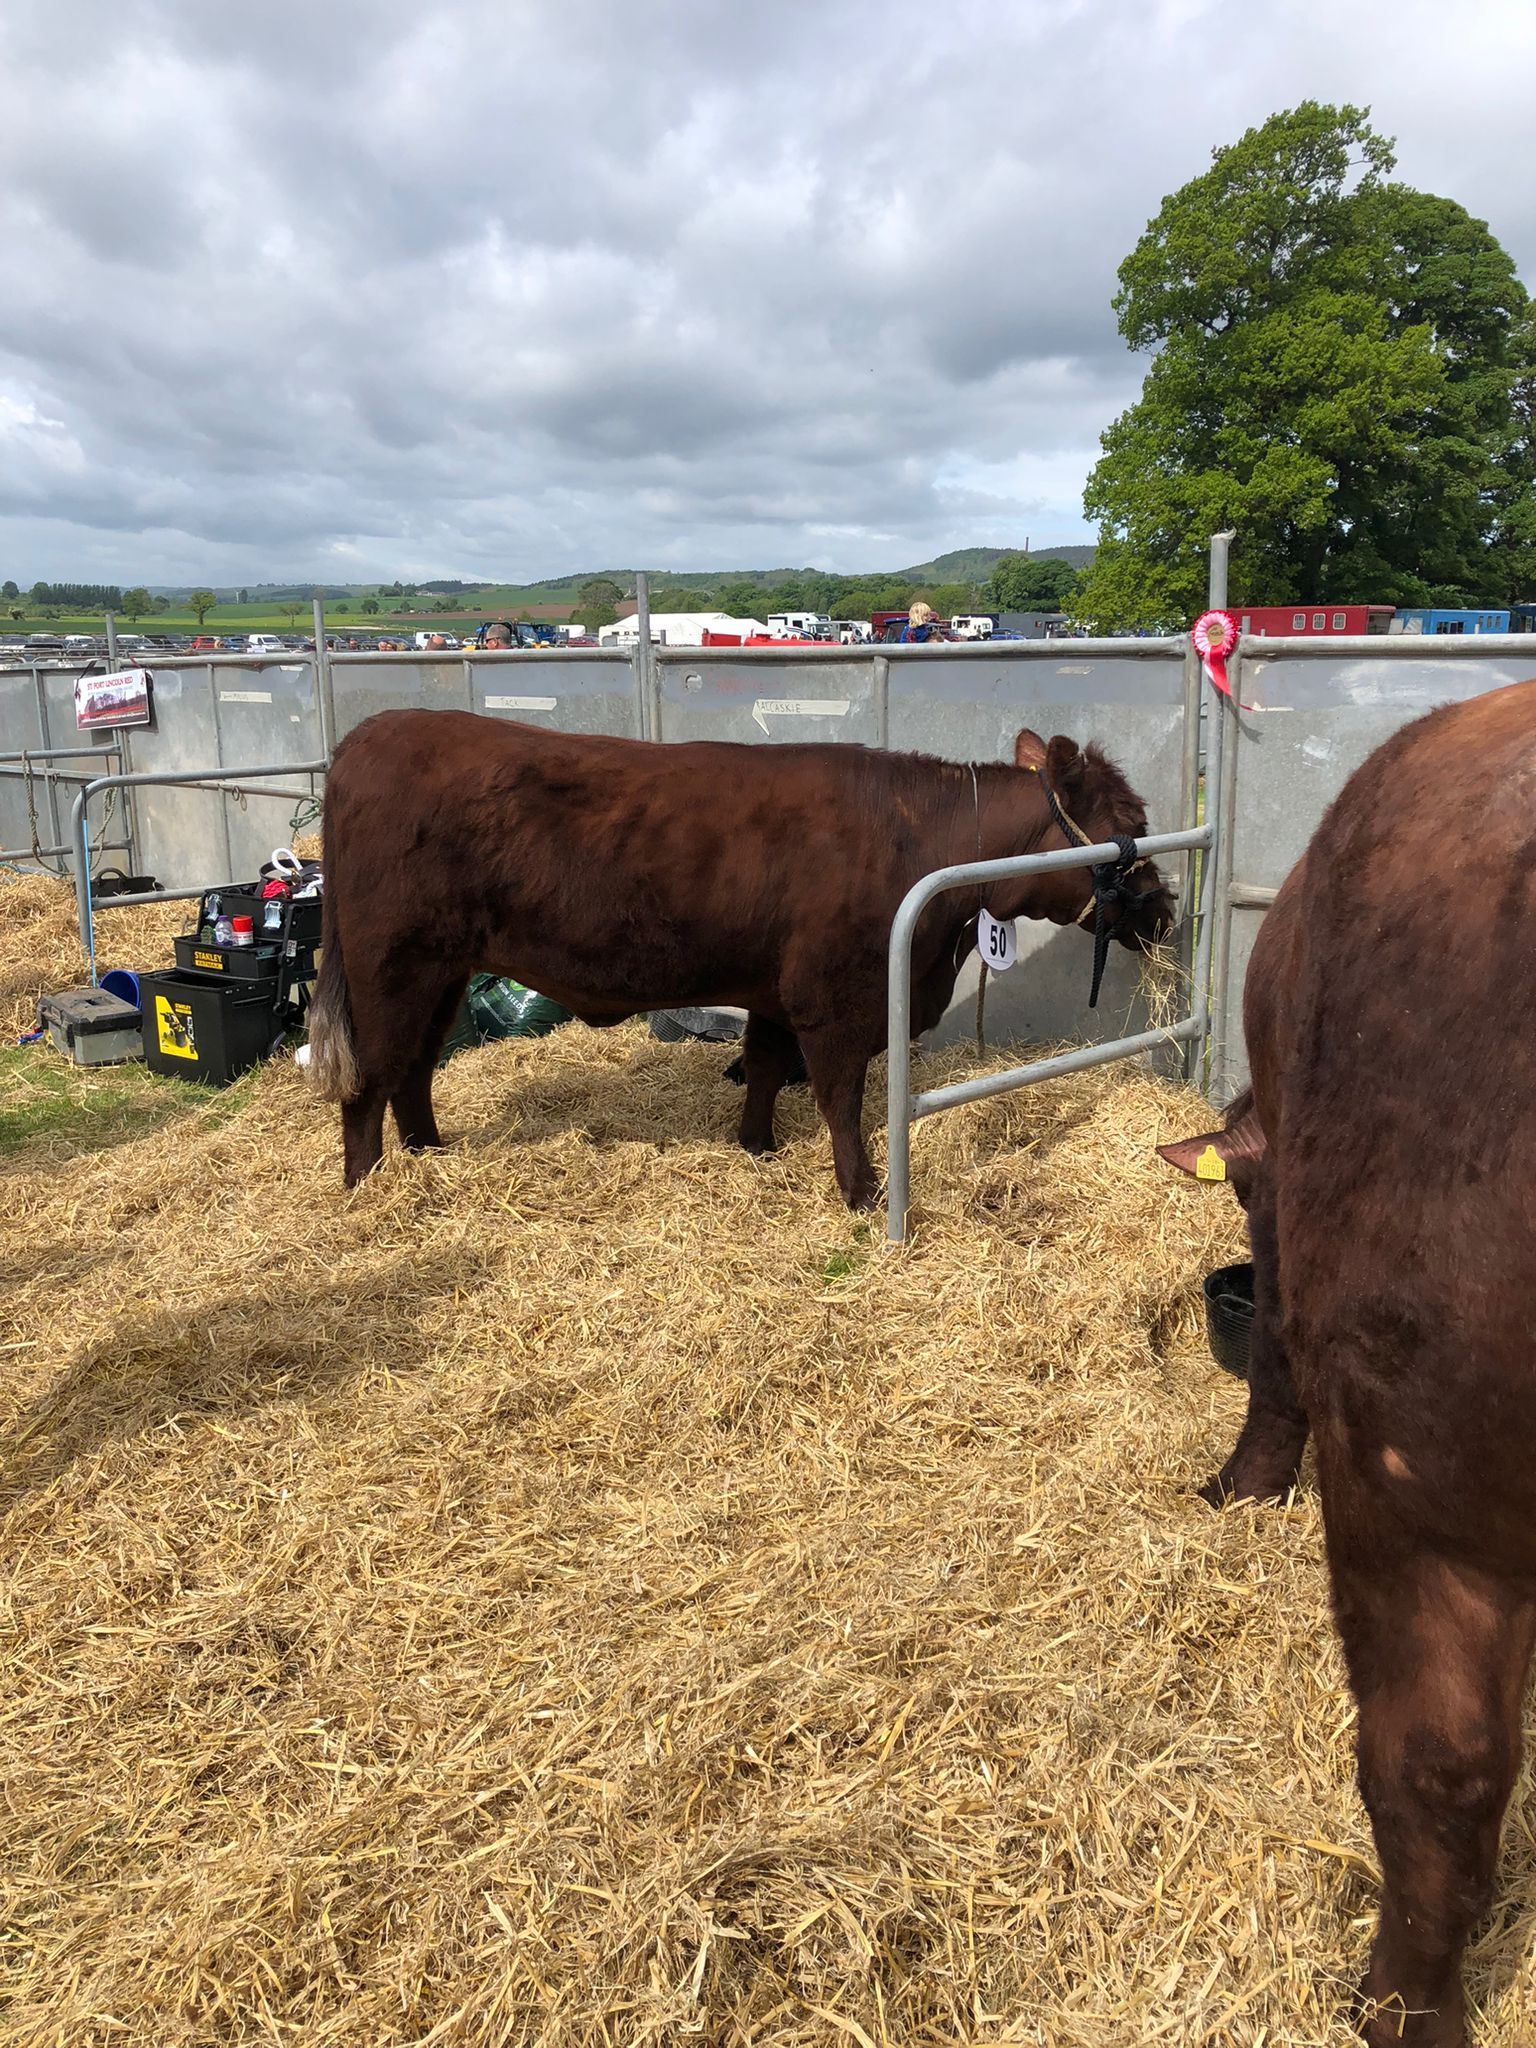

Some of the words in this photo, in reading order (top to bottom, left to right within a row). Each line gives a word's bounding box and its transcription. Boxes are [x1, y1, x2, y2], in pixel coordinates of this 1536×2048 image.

[106, 678, 123, 687] LINCOLN
[125, 675, 133, 684] RED
[990, 924, 1007, 958] 50
[194, 951, 222, 962] STANLEY
